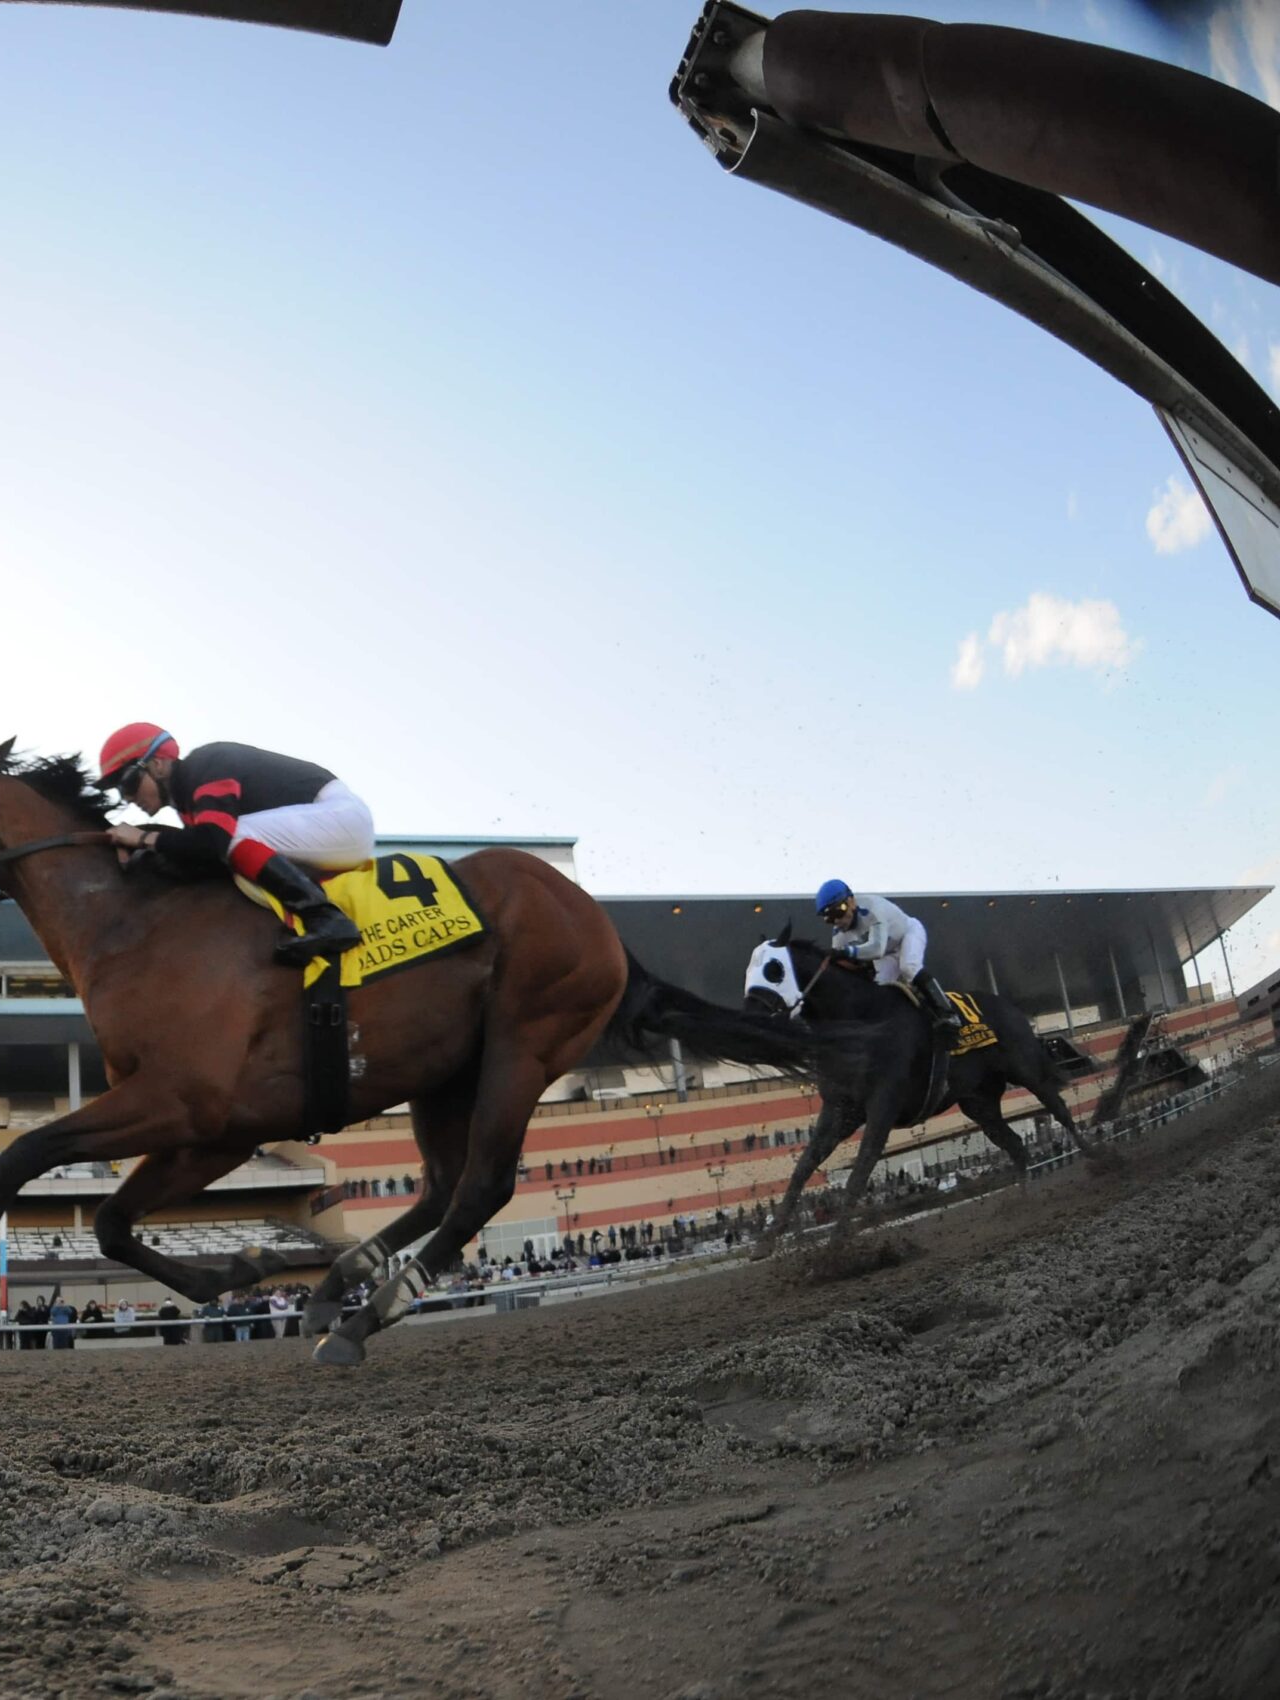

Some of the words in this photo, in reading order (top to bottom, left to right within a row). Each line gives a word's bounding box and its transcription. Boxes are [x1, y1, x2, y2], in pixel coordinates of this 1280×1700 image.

[376, 853, 439, 907] 4
[358, 938, 407, 971] ADS
[412, 916, 471, 948] CAPS
[359, 923, 386, 946] THE
[386, 907, 446, 935] CARTER
